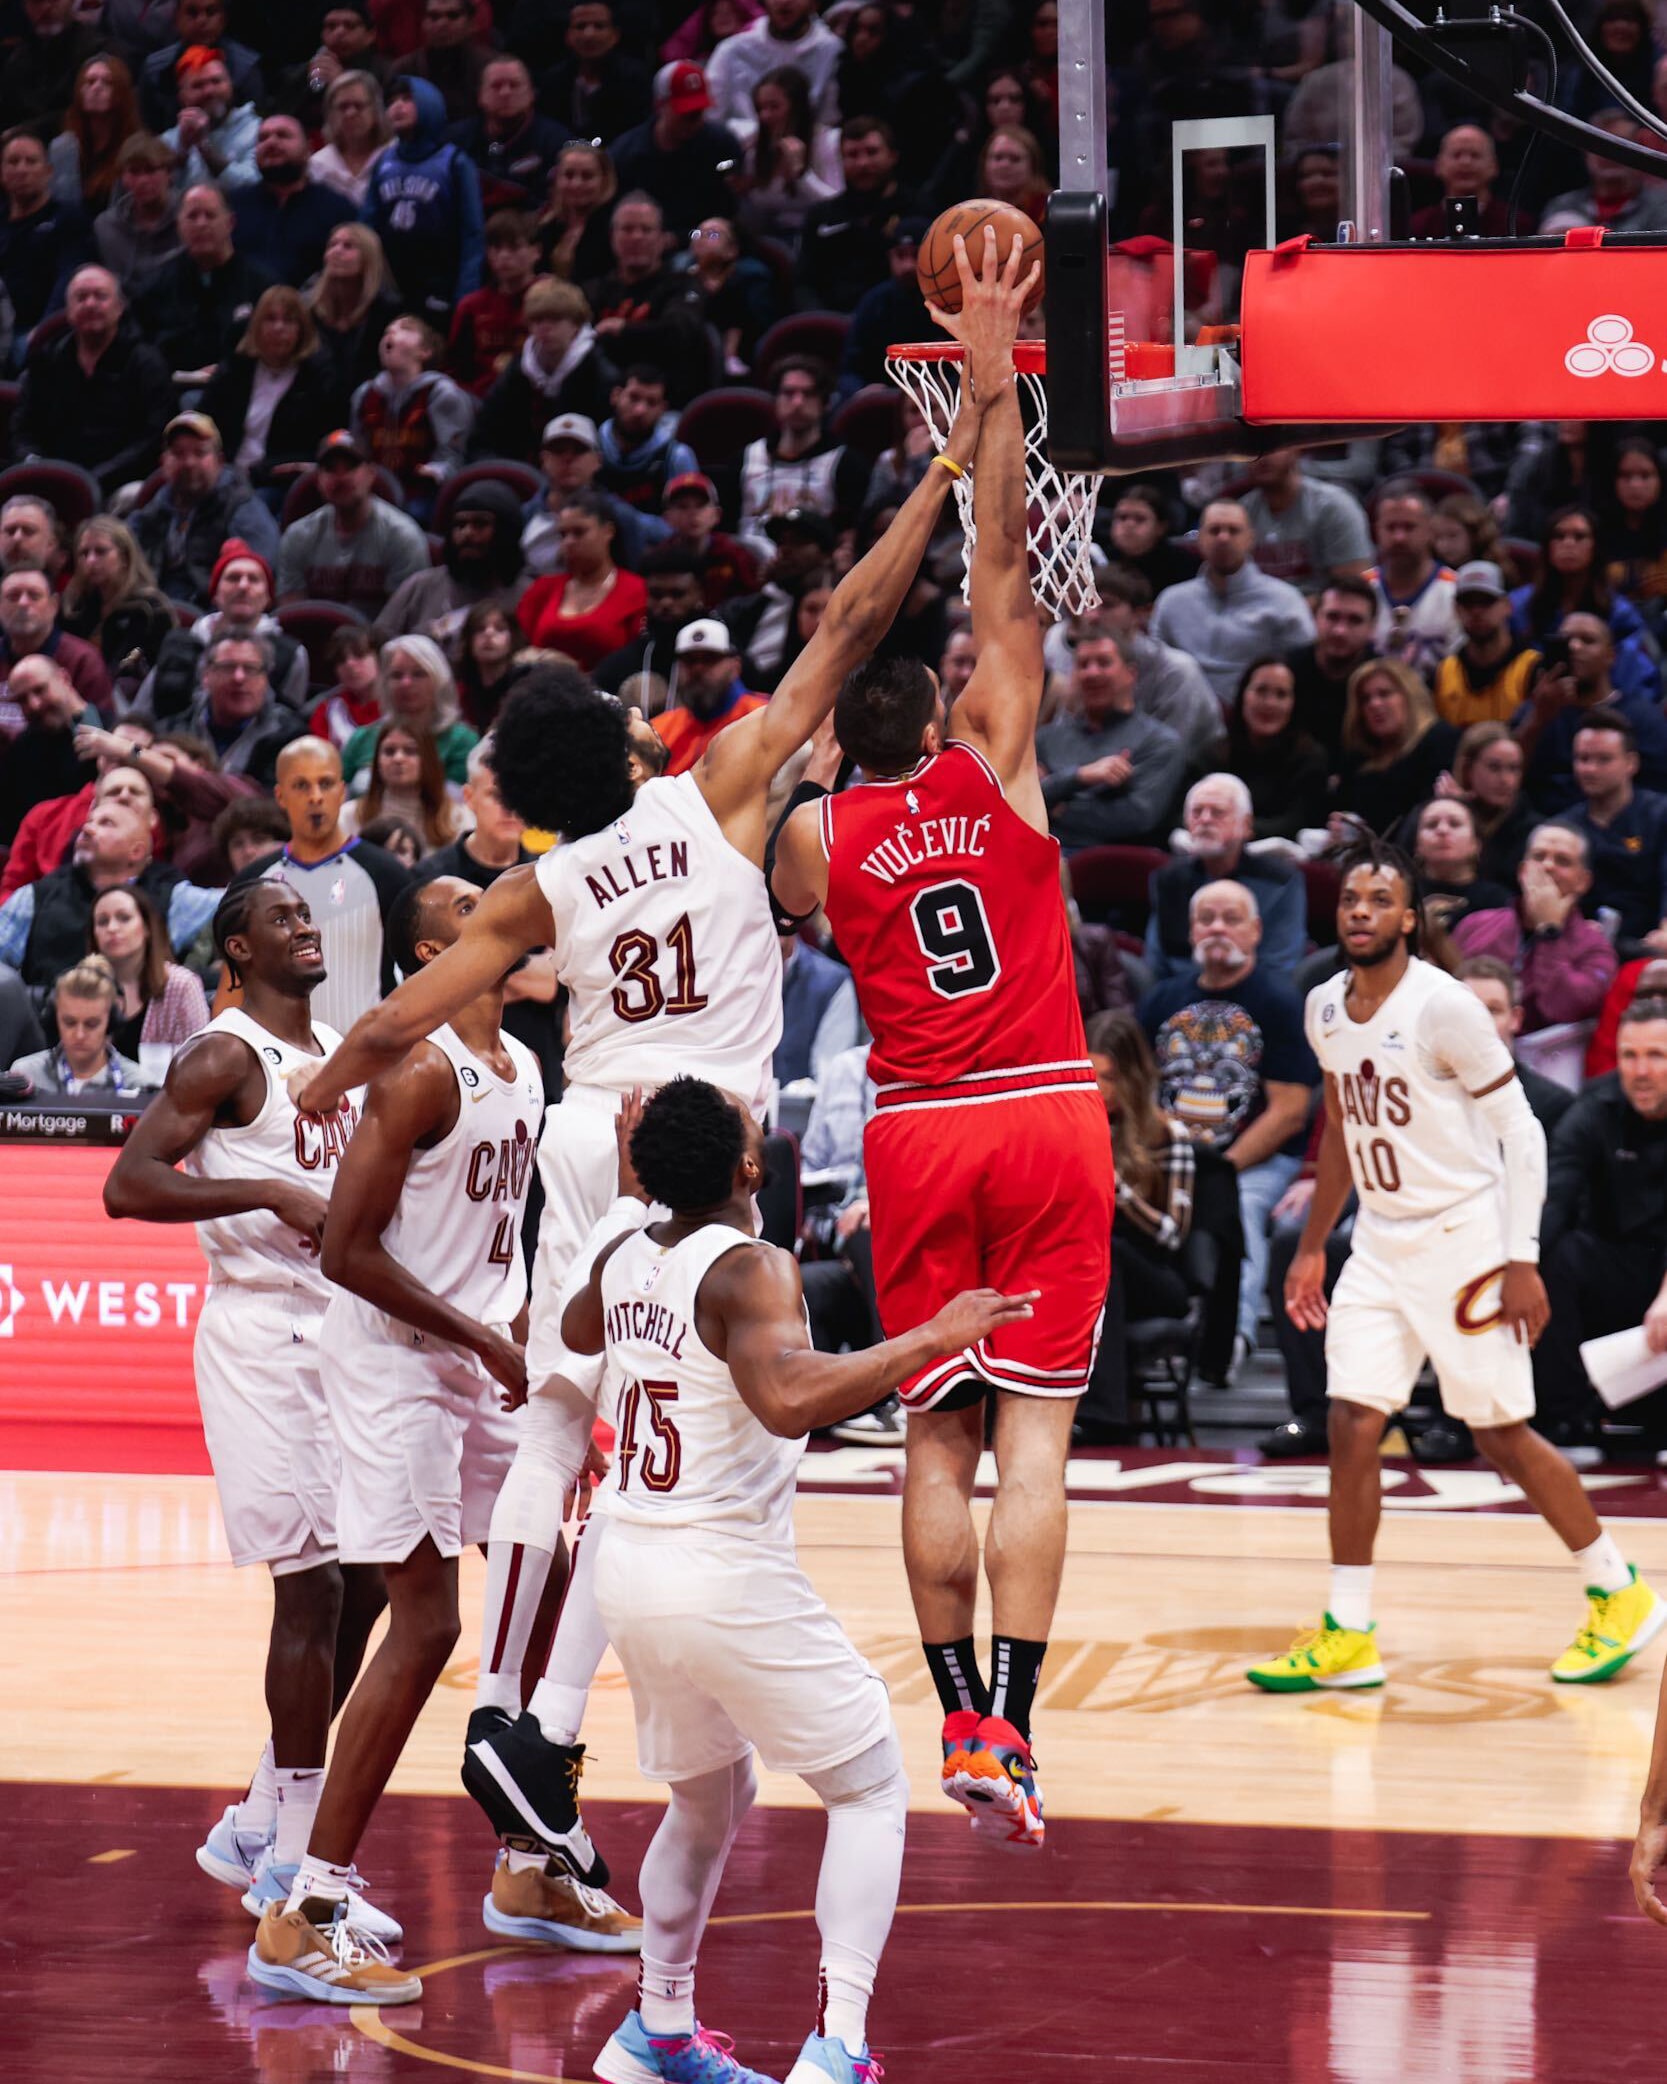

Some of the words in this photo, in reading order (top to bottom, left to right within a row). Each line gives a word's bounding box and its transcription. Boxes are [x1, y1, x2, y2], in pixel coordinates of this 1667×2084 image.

[585, 841, 688, 909] ALLEN
[859, 813, 991, 884] VUČEVIĆ
[608, 911, 708, 1023] 31
[909, 877, 1001, 1000] 9
[7, 1112, 87, 1136] Mortgage
[1343, 1072, 1411, 1127] AVS
[466, 1138, 538, 1202] CAV
[1356, 1138, 1401, 1191] 10
[488, 1213, 514, 1280] 4
[41, 1280, 212, 1328] WEST
